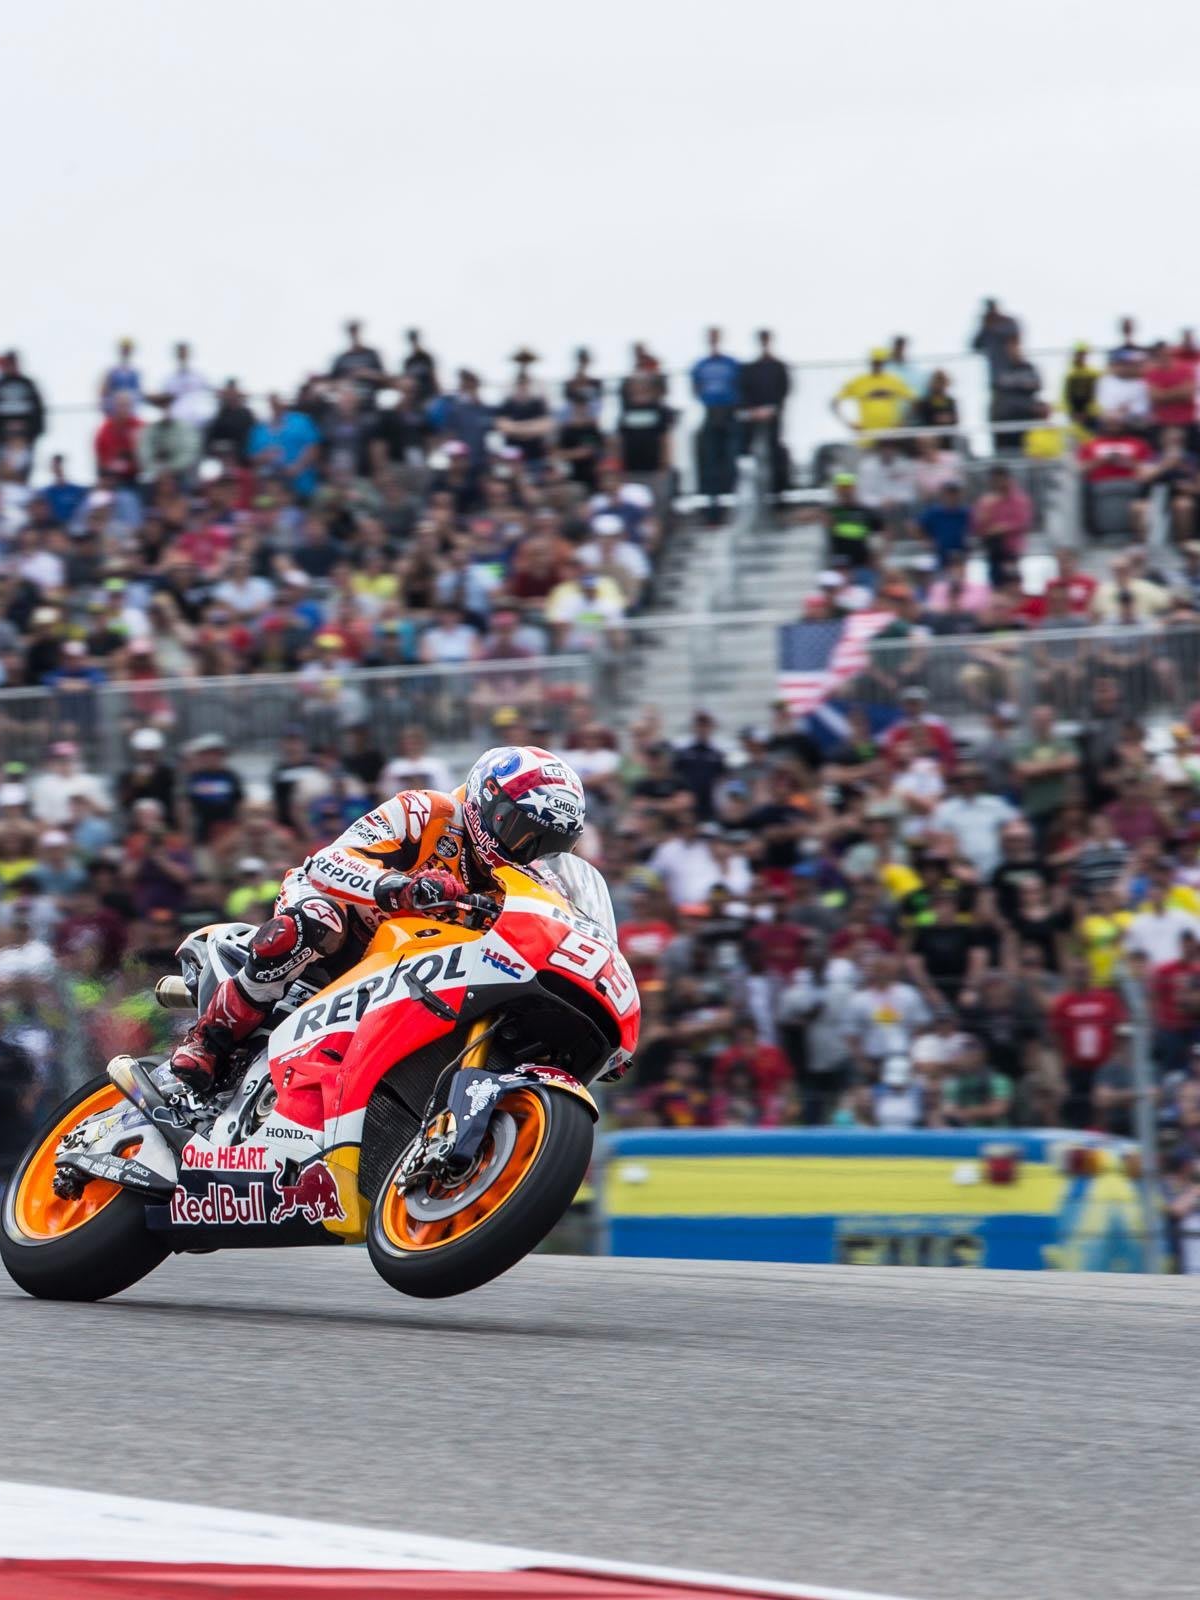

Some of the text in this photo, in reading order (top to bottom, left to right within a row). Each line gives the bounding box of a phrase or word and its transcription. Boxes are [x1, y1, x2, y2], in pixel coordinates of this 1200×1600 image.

[527, 812, 550, 828] GIVES
[553, 798, 577, 816] SHOEI
[315, 857, 372, 892] REPSOL
[483, 948, 526, 980] HRC
[548, 931, 636, 1016] 93
[293, 946, 467, 1041] REPSOL
[132, 1165, 151, 1177] asics
[184, 1145, 266, 1170] One HEART.
[171, 1183, 267, 1225] Red Bull
